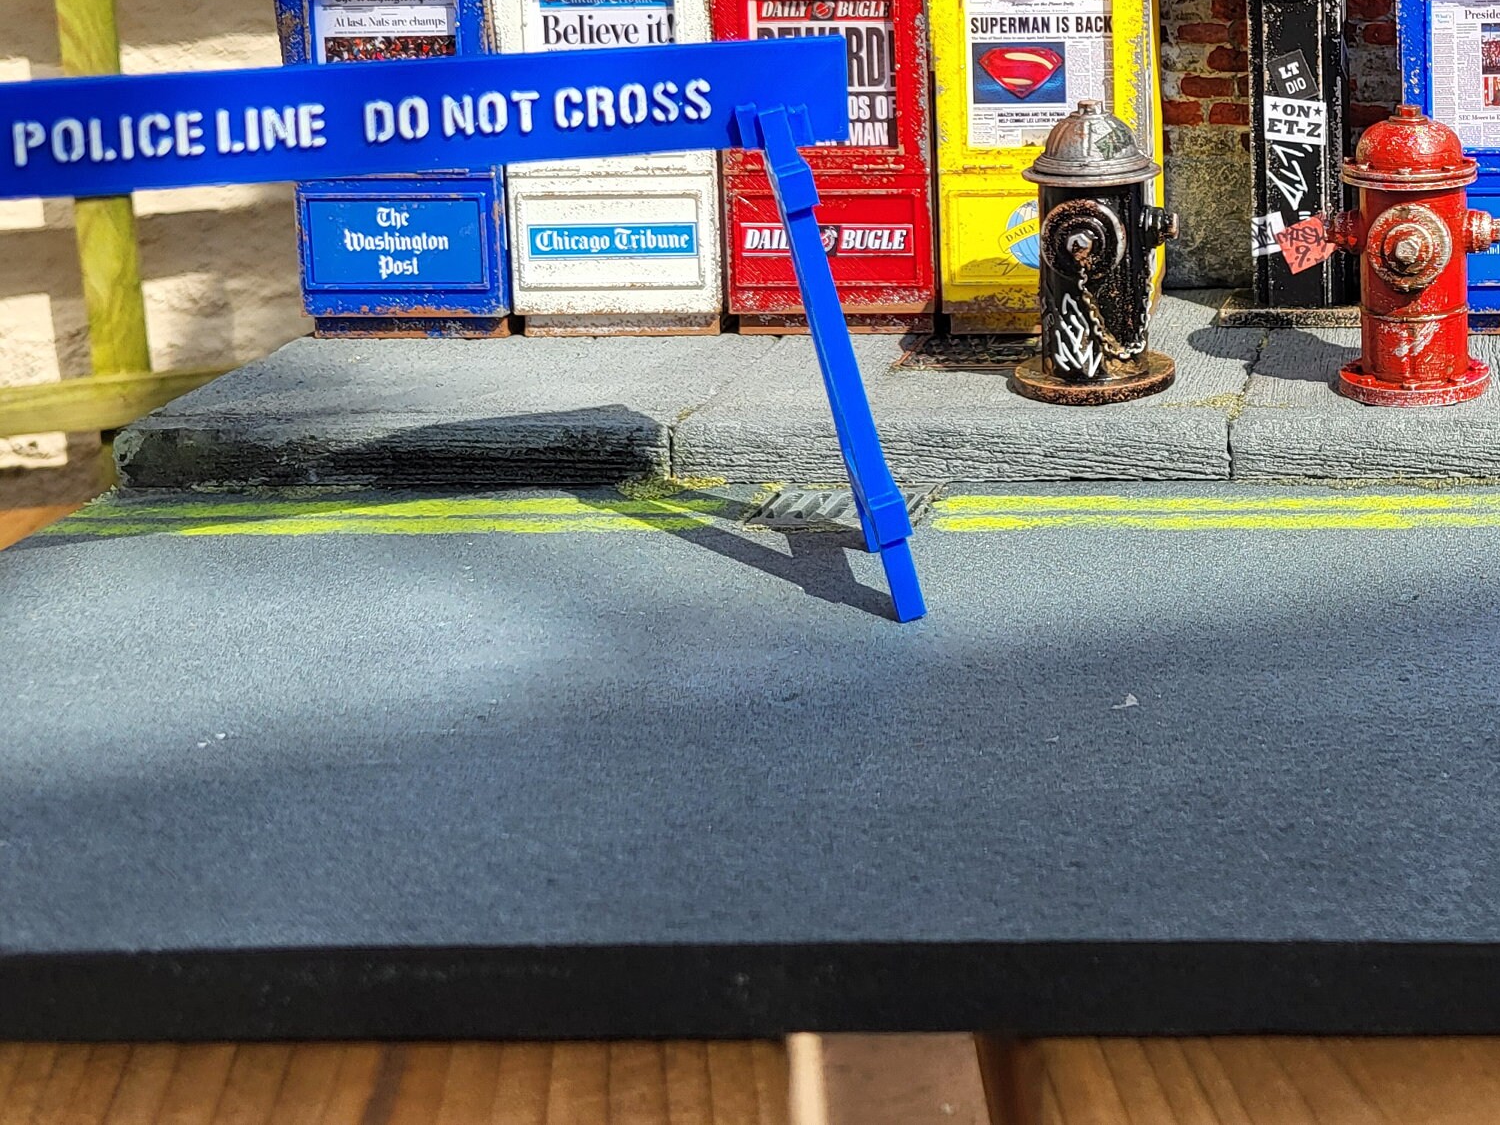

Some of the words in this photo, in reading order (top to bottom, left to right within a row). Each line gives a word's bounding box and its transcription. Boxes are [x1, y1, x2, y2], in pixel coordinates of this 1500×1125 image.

[761, 1, 810, 18] DAILY
[836, 1, 890, 18] BUGLE
[334, 17, 345, 27] At
[369, 16, 390, 27] Nats
[392, 18, 407, 26] are
[409, 16, 446, 28] champs
[541, 14, 639, 45] Believe
[646, 13, 676, 44] it!
[970, 16, 1051, 34] SUPERMAN
[1056, 16, 1070, 33] IS
[1075, 16, 1113, 33] BACK
[1278, 60, 1300, 80] LT
[1285, 75, 1307, 96] DIO
[1282, 101, 1312, 119] ON
[13, 111, 205, 167] POLICE
[216, 101, 328, 155] LINE
[364, 94, 430, 144] DO
[441, 88, 541, 138] NOT
[552, 78, 713, 130] CROSS
[1266, 117, 1323, 139] ET-Z
[375, 207, 410, 228] The
[343, 229, 449, 253] Washington
[534, 229, 610, 253] Chicago
[612, 227, 691, 250] Tribune
[840, 229, 907, 250] BUGLE
[1004, 221, 1036, 243] DAILY
[378, 257, 420, 280] Post
